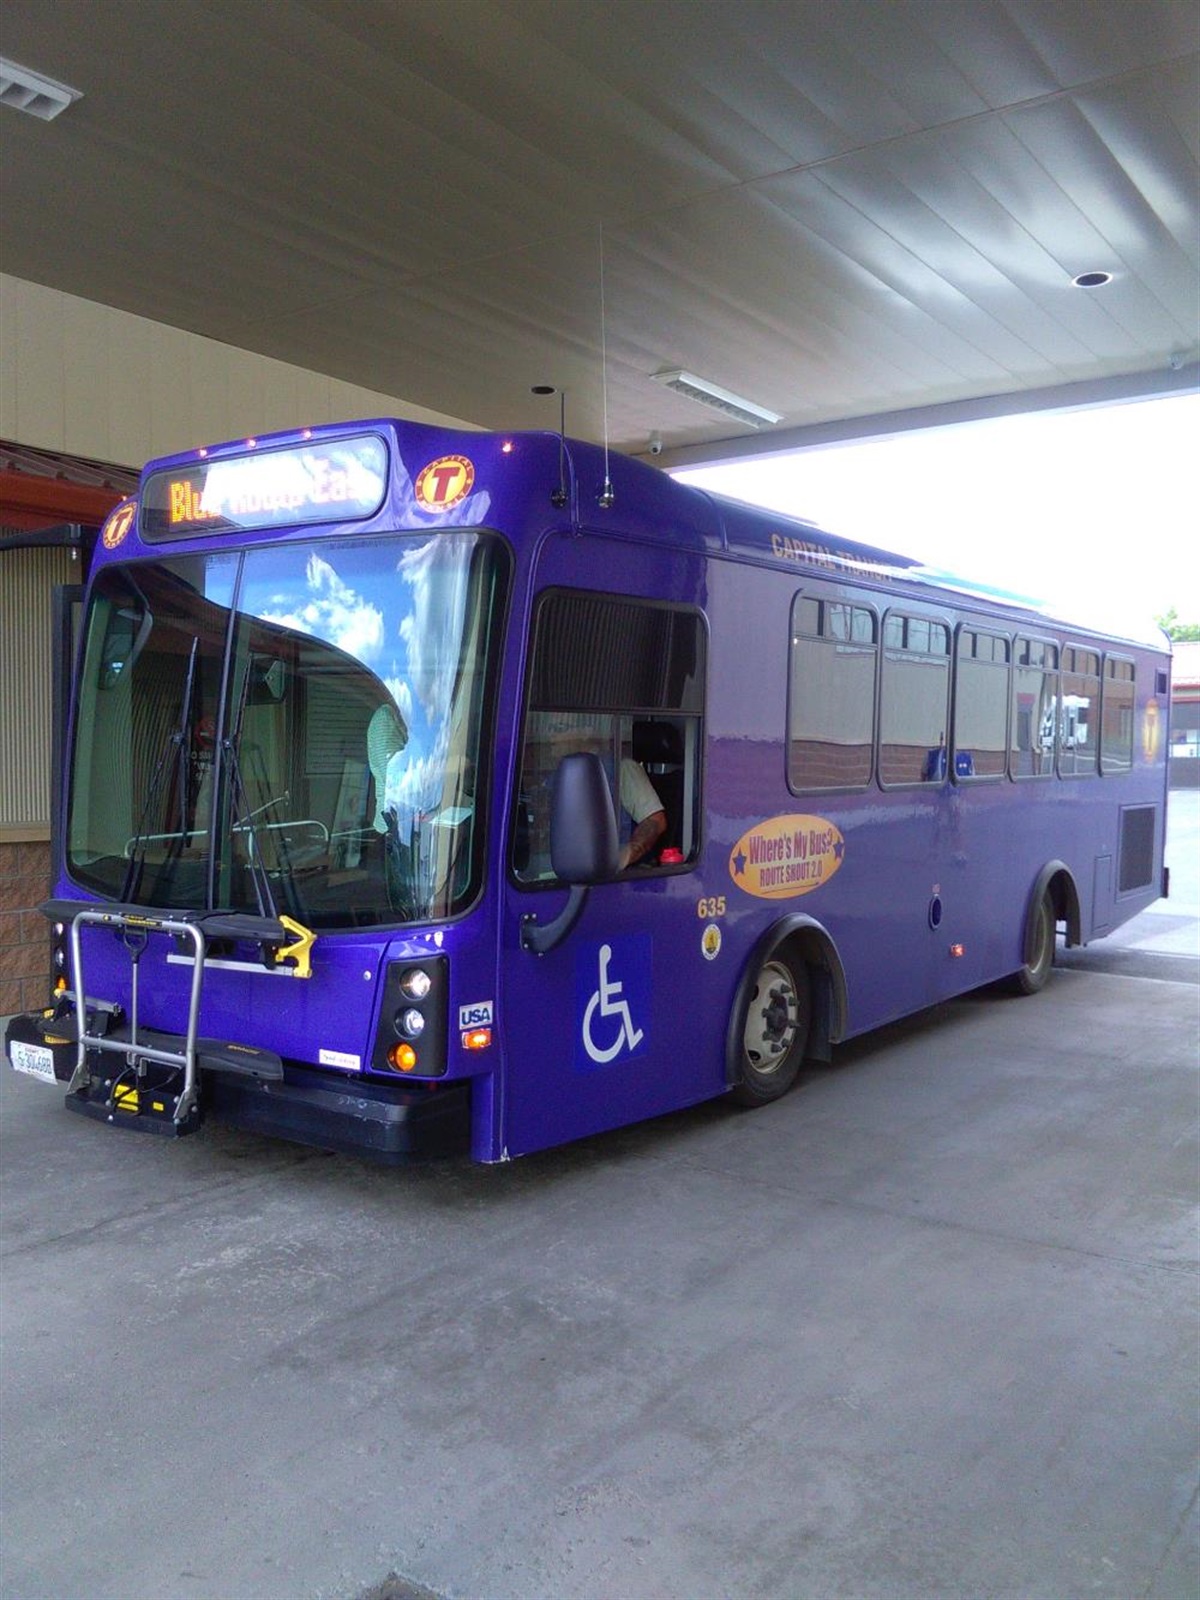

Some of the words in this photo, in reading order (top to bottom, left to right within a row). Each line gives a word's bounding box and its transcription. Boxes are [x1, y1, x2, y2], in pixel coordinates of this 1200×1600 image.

[432, 466, 461, 502] T
[749, 832, 792, 865] Where's
[794, 830, 808, 860] My
[809, 828, 833, 856] Bus?
[760, 866, 785, 887] ROUTE
[785, 861, 810, 882] SHOUT
[811, 860, 823, 879] 2.0
[697, 896, 726, 919] 635
[461, 1007, 490, 1025] USA
